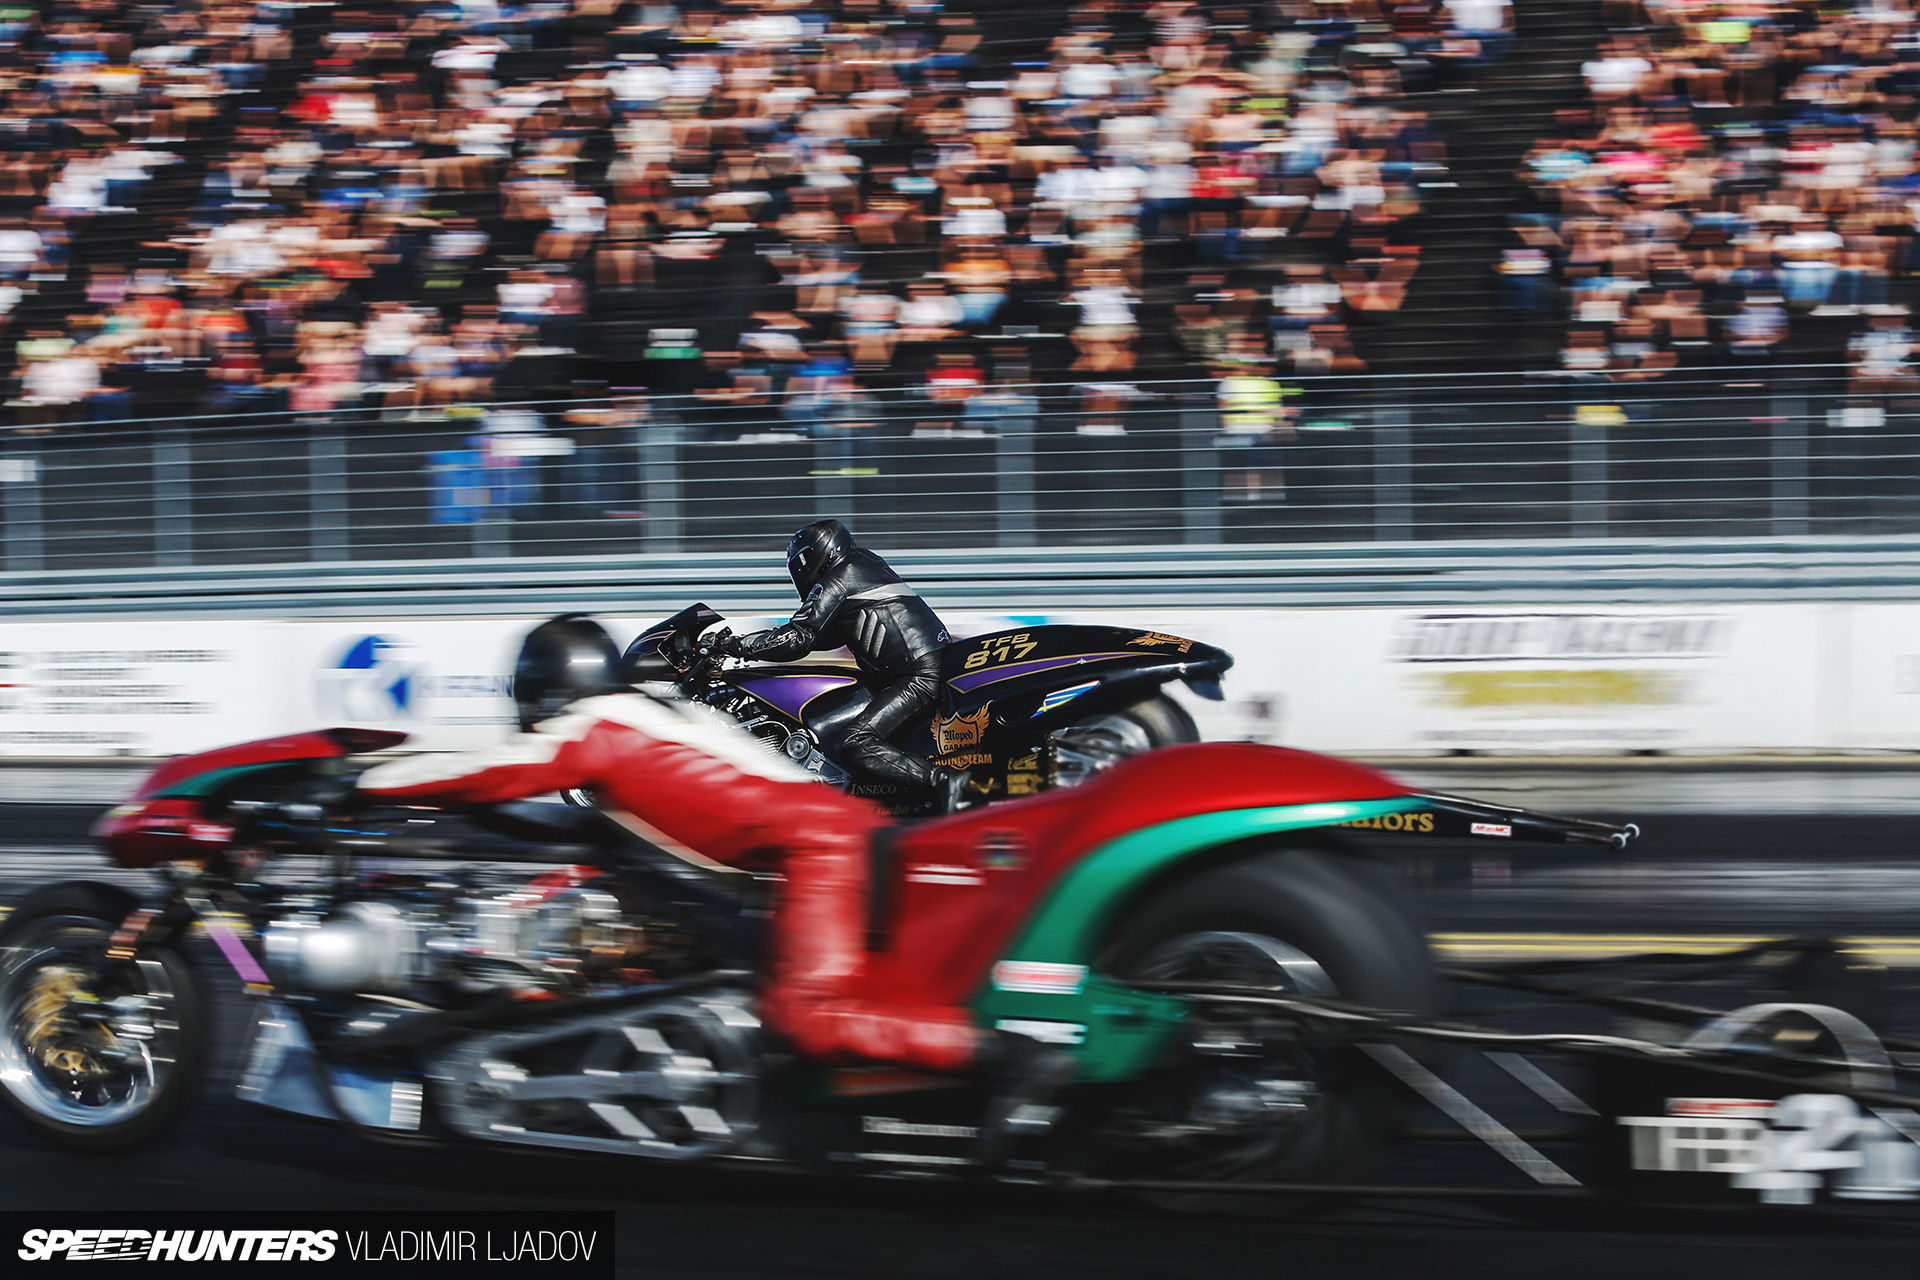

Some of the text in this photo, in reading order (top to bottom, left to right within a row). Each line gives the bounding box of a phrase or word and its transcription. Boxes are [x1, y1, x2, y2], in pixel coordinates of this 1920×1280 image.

[980, 632, 1031, 650] TFB
[963, 640, 1039, 670] 817
[943, 729, 974, 742] Moped
[851, 783, 897, 795] INSECO
